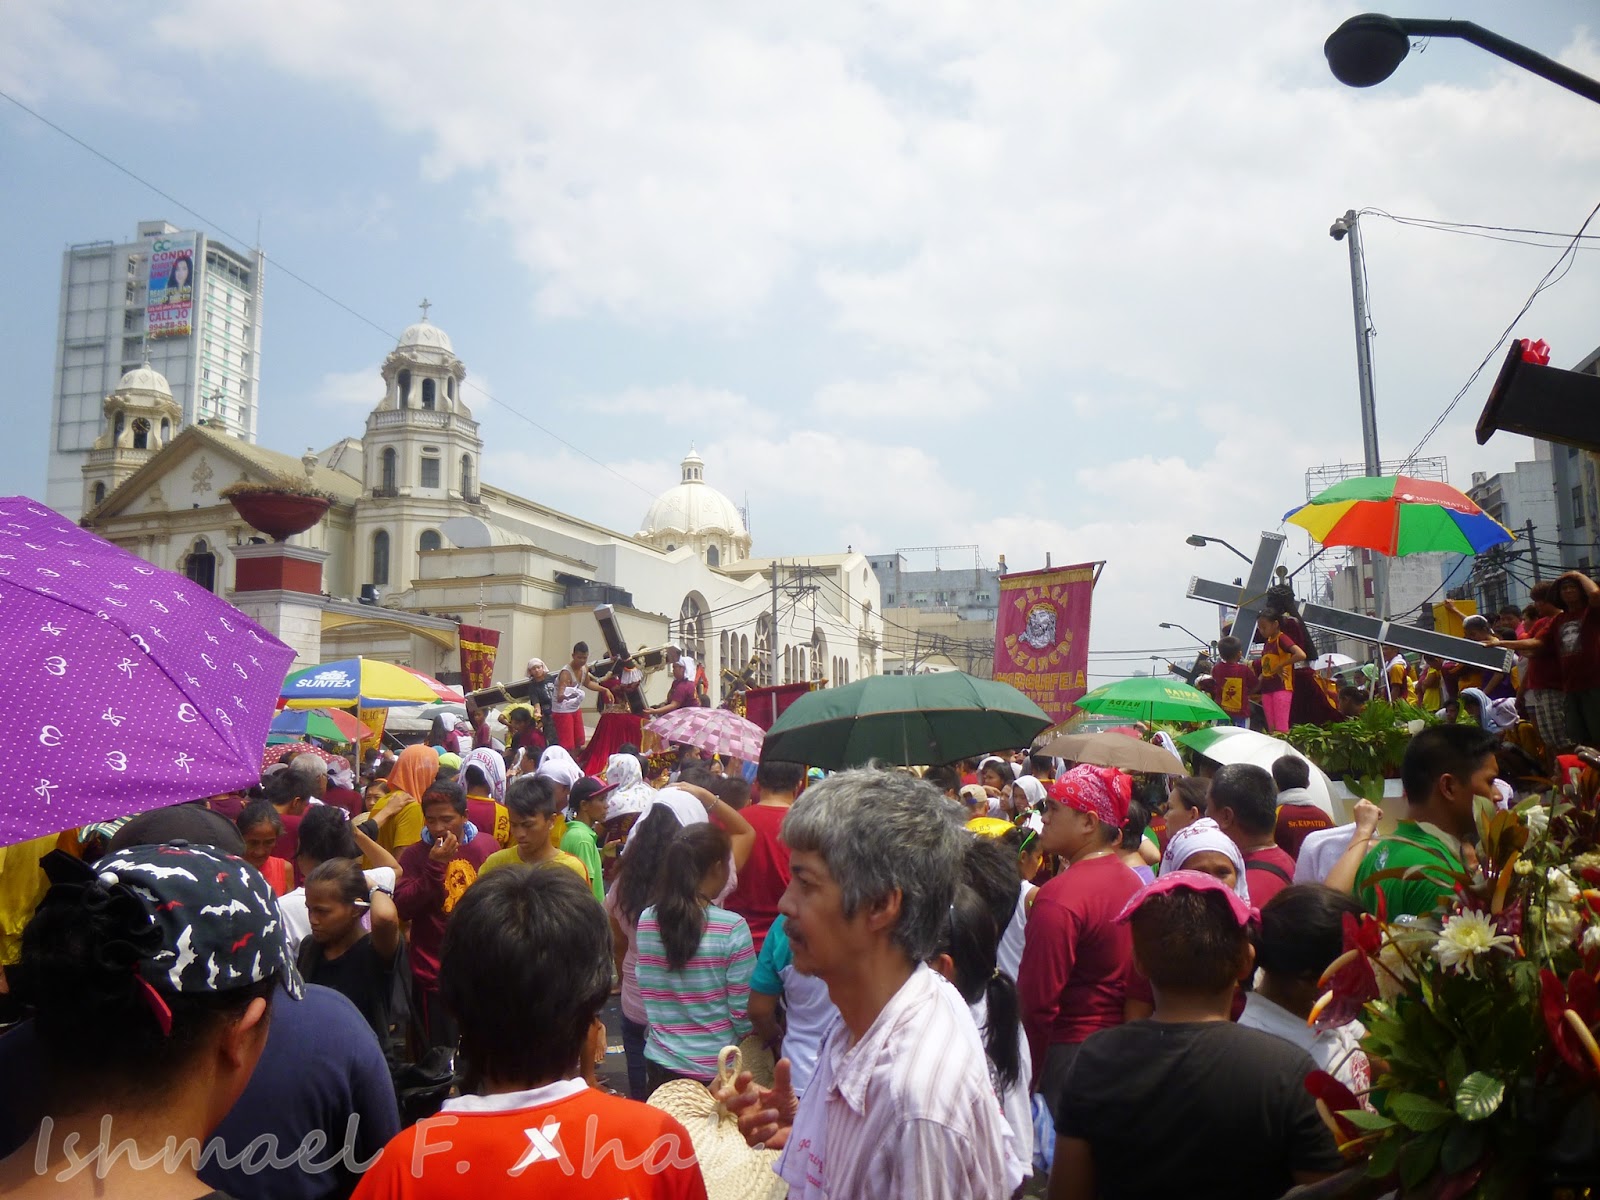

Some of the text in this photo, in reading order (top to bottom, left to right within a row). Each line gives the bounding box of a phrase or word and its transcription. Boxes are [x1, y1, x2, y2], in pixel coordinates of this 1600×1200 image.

[152, 249, 193, 262] CONDO
[149, 309, 189, 322] CALL JO
[295, 678, 356, 688] SUNTEX
